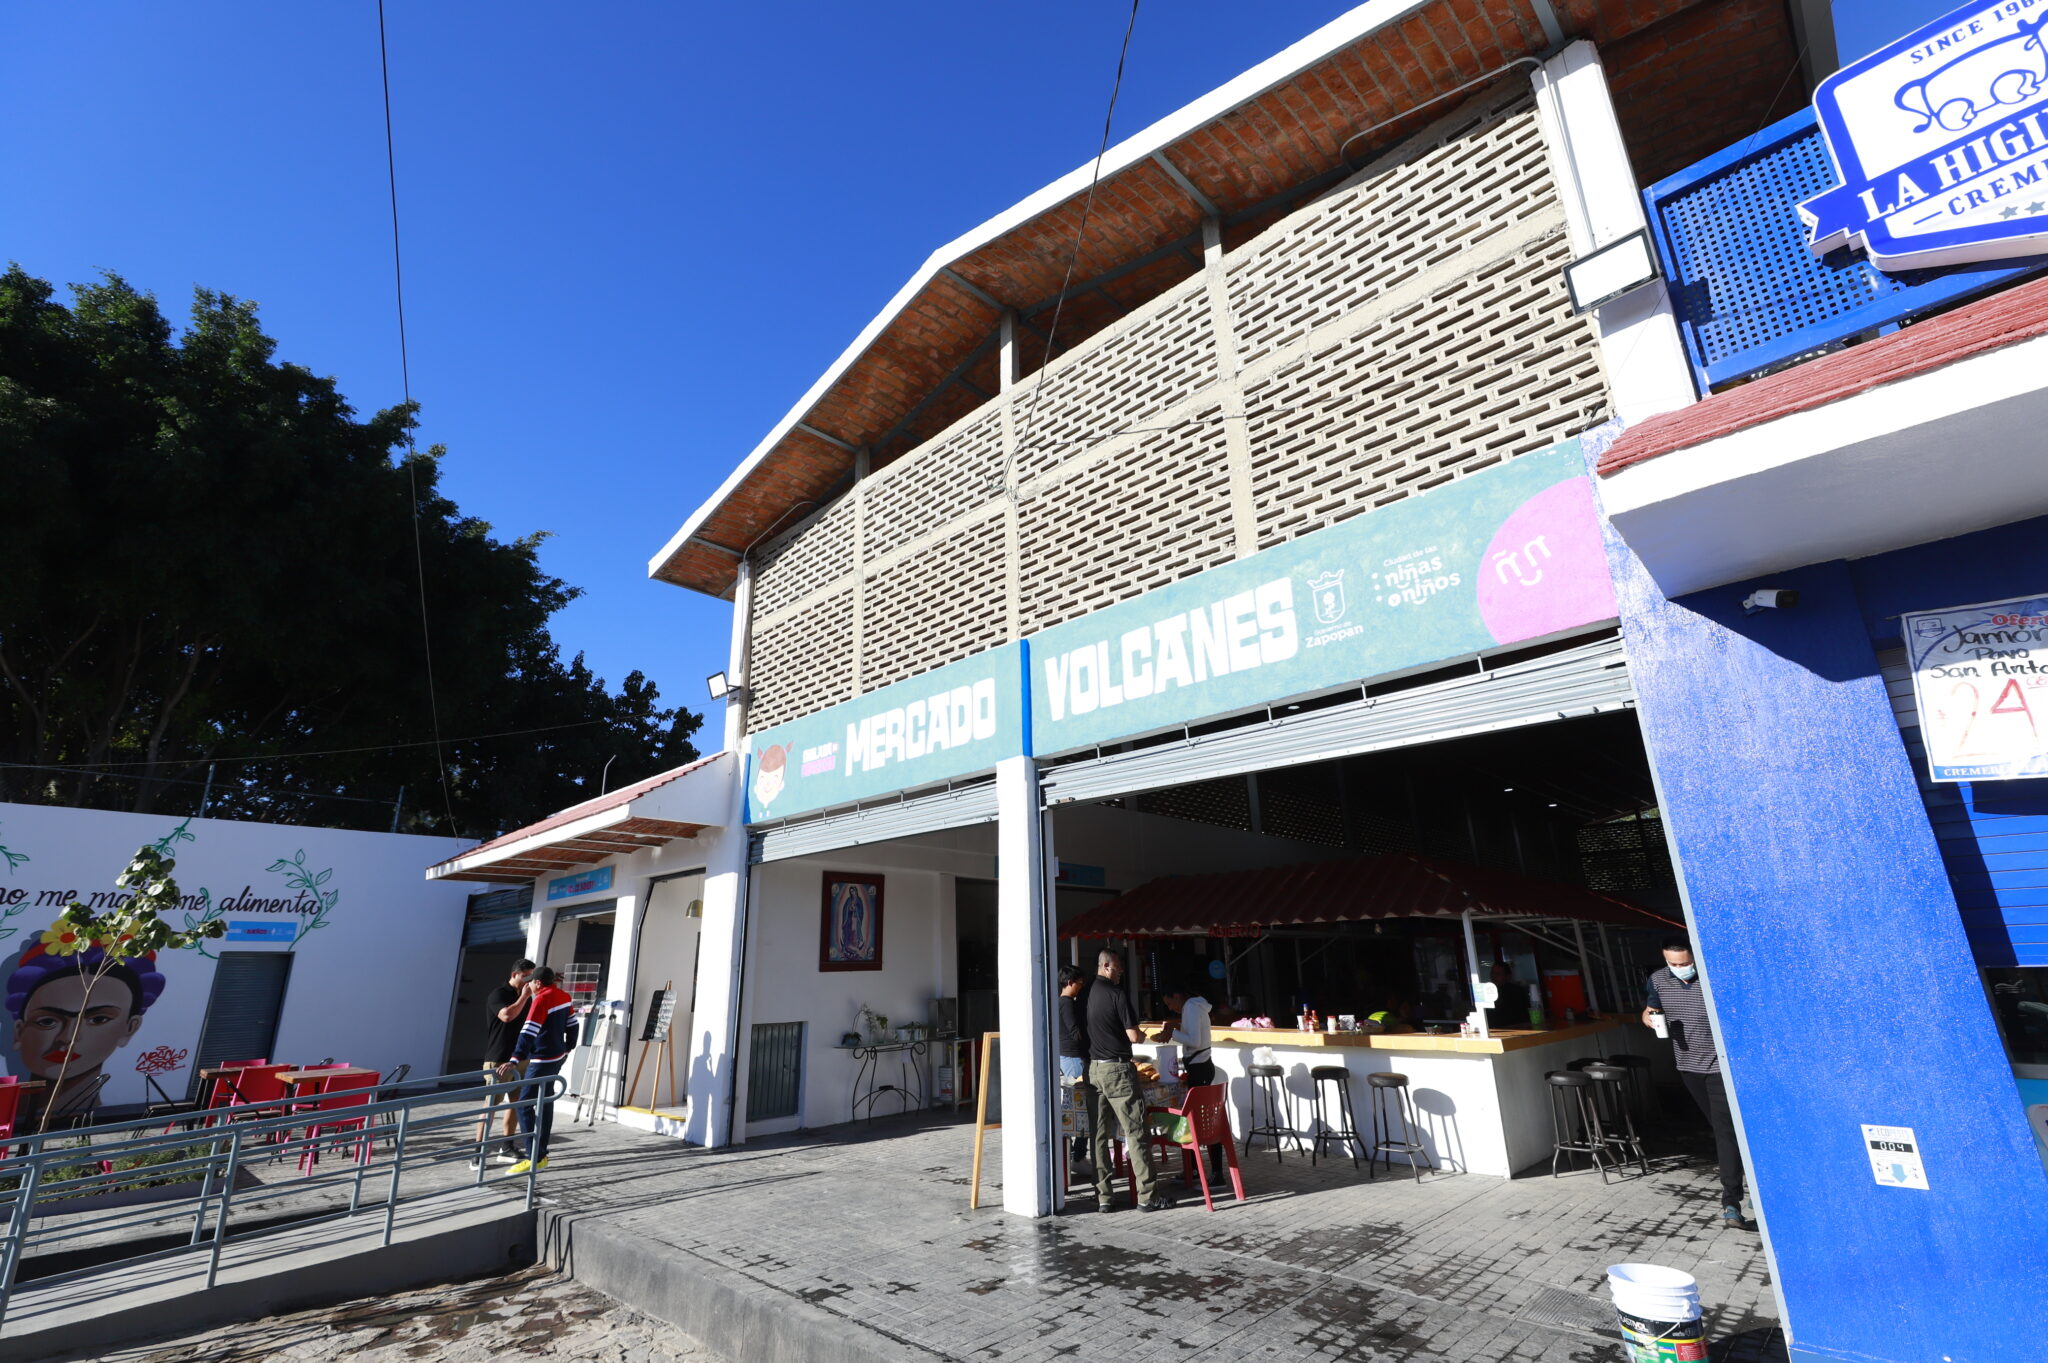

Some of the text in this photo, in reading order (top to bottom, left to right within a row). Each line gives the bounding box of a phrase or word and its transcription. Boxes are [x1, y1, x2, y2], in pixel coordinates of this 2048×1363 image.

[1910, 20, 1983, 64] SINCE
[1858, 107, 2048, 222] LA HIGI
[1385, 556, 1442, 587] niñas
[1045, 577, 1298, 721] VOLCANES
[1305, 625, 1364, 648] Zapopan
[1964, 646, 2030, 660] Pavo
[1930, 664, 1981, 678] San
[845, 678, 996, 776] MERCADO
[35, 889, 78, 907] me
[1879, 1141, 1905, 1152] 004
